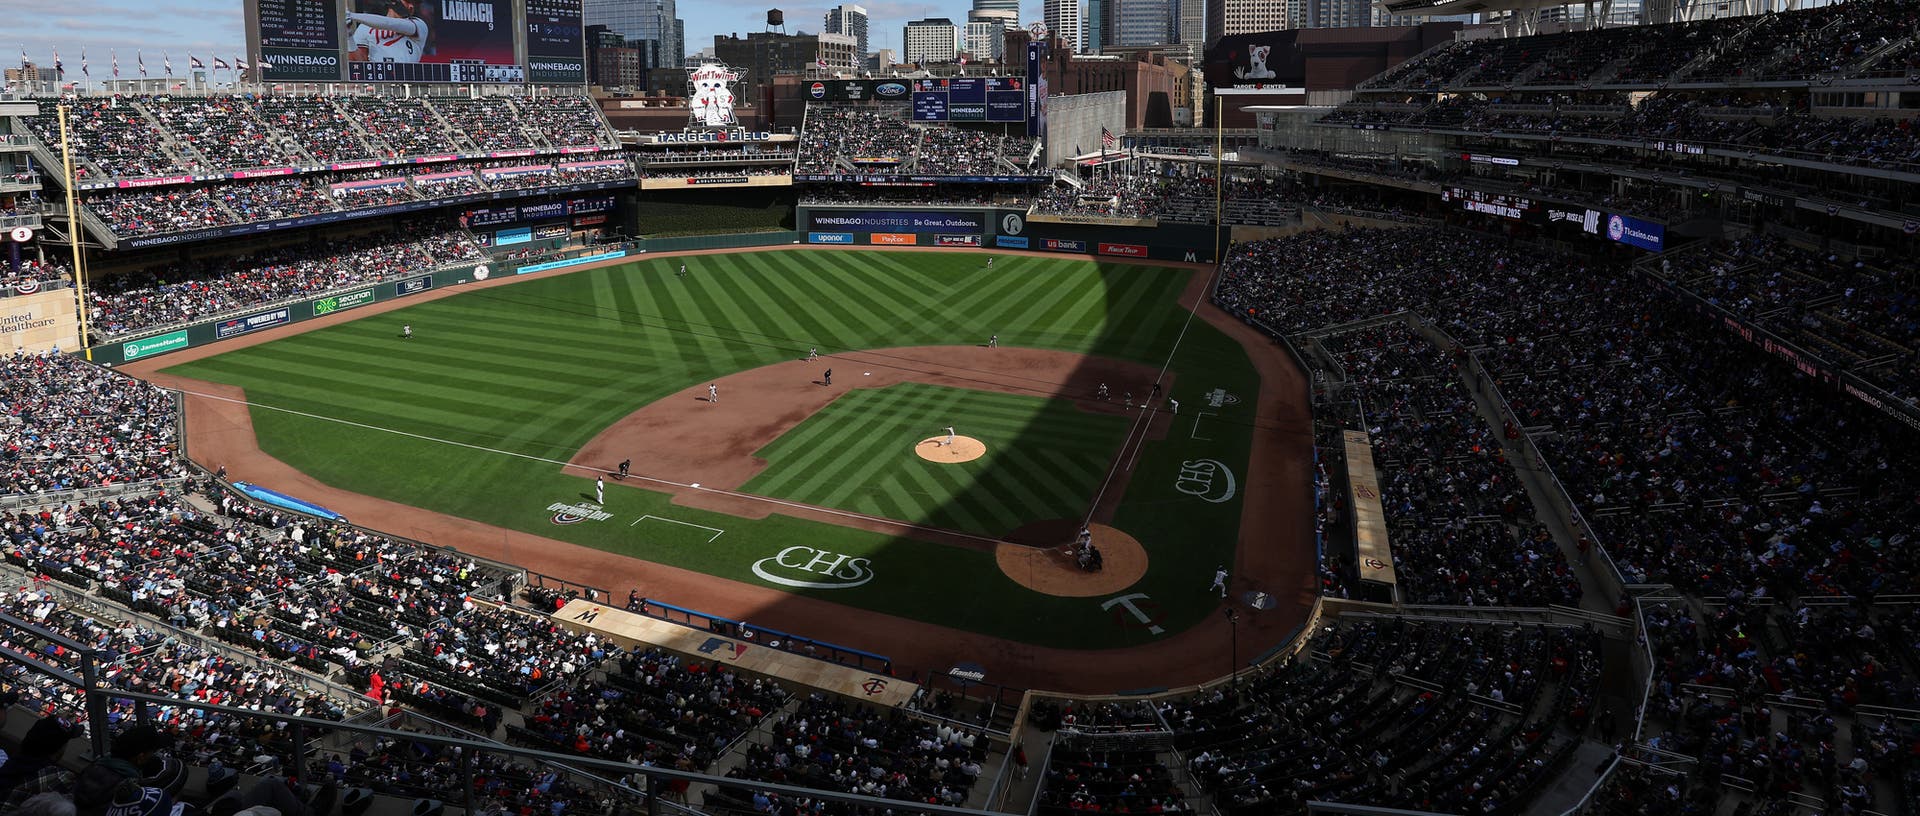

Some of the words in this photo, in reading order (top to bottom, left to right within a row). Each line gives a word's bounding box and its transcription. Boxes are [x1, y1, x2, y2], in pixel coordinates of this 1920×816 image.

[441, 0, 494, 23] LARNACH
[488, 22, 494, 31] 9
[265, 54, 337, 66] WINNEBAGO
[269, 65, 336, 74] INDUSTRIES
[529, 62, 582, 71] WINNEBAGO
[691, 70, 710, 81] Win!
[711, 70, 737, 81] Twins!
[881, 86, 900, 95] Ford
[659, 133, 716, 142] TARGET
[730, 131, 770, 141] FIELD
[128, 179, 162, 187] Treasure
[163, 177, 186, 185] Island
[345, 209, 377, 218] WINNEBAGO
[522, 203, 562, 213] WINNEBAGO
[1475, 202, 1497, 215] OPENING
[1497, 205, 1507, 217] DAY
[1507, 206, 1521, 219] 2025
[815, 217, 861, 225] WINNEBAGO
[861, 218, 909, 226] INDUSTRIES
[924, 219, 945, 227] Great,
[945, 219, 978, 227] Outdoors.
[1547, 209, 1566, 222] Twins
[1583, 208, 1600, 234] ONE
[131, 235, 179, 248] WINNEBAGO
[178, 230, 223, 241] INDUSTRIES
[818, 234, 844, 242] uponor
[1058, 240, 1078, 249] bank
[1184, 252, 1197, 263] M
[338, 291, 371, 304] securian
[247, 314, 270, 326] POWERED
[270, 313, 277, 321] BY
[277, 310, 287, 319] YOU
[140, 336, 186, 352] JamesHardie
[1845, 383, 1881, 409] WINNEBAGO
[1880, 400, 1920, 431] INDUSTRIES
[1175, 459, 1216, 496] CHS
[547, 502, 593, 518] OPENING
[587, 510, 614, 521] DAY
[776, 545, 872, 580] CHS
[573, 610, 599, 624] M
